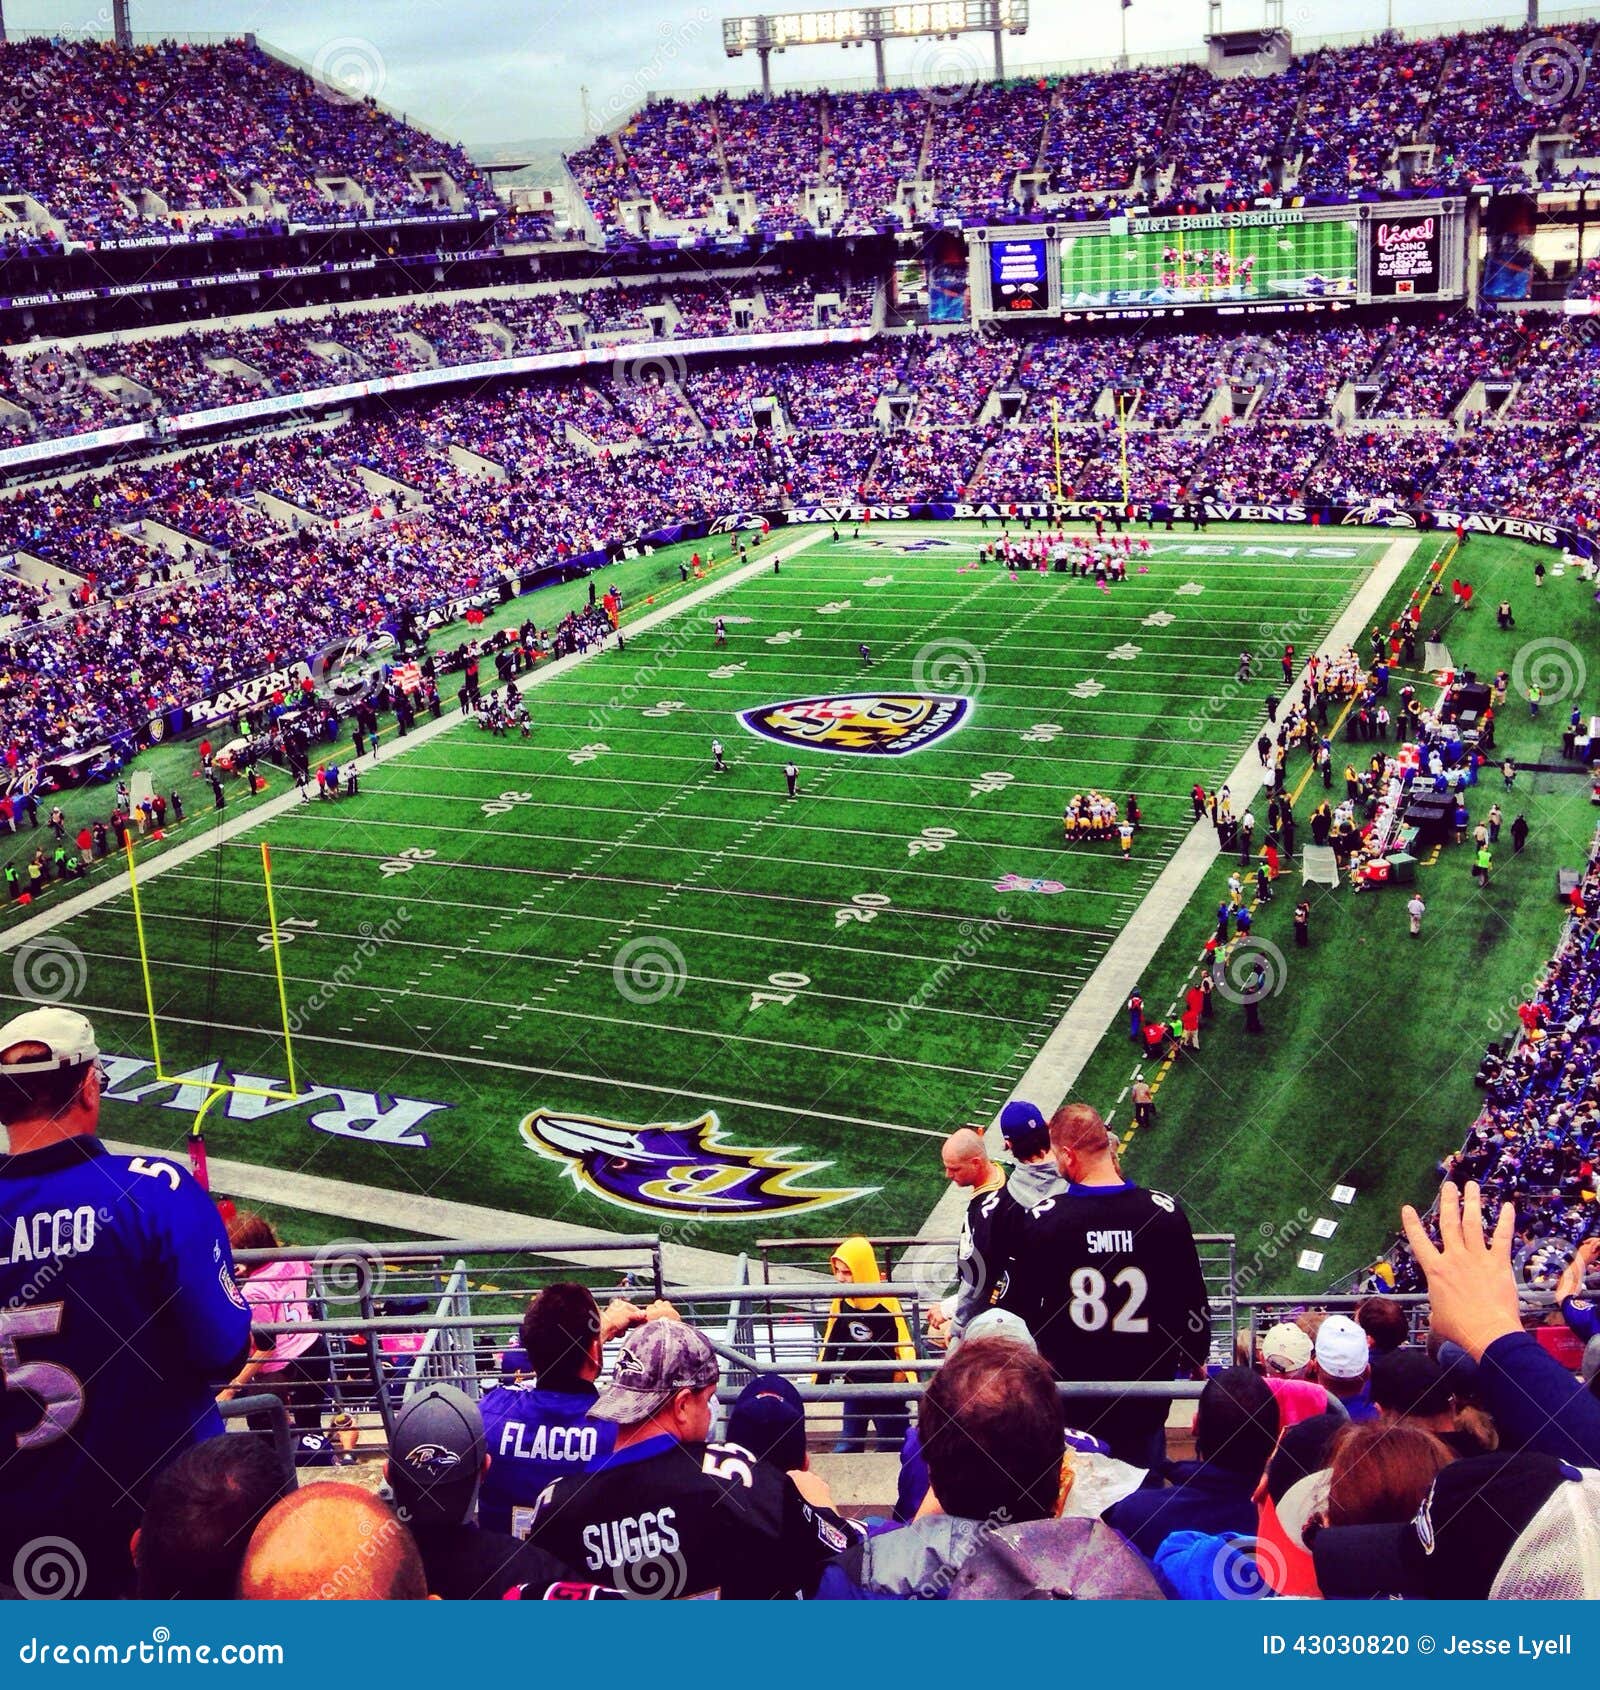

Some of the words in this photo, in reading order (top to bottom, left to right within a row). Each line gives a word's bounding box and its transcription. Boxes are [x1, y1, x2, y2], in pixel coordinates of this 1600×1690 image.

[1133, 217, 1169, 233] M&T
[1180, 214, 1223, 230] Bank
[1231, 209, 1304, 227] Stadium
[1378, 218, 1434, 246] Live!
[100, 242, 117, 250] AFC
[119, 235, 168, 249] CHAMPIONS
[1384, 242, 1426, 252] CASINO
[1396, 251, 1429, 260] SCORE
[783, 505, 909, 522] RAVENS
[1436, 511, 1558, 544] RAVENS
[886, 701, 957, 750] RAVENS
[568, 742, 611, 764] 40
[976, 770, 1015, 795] 40
[482, 791, 533, 816] 30
[909, 827, 959, 853] 30
[379, 847, 437, 877] 20
[836, 893, 892, 925] 20
[257, 917, 318, 950] 10
[751, 971, 812, 1008] 10
[127, 1155, 182, 1193] 5
[1086, 1230, 1133, 1254] SMITH
[1069, 1265, 1150, 1333] 82
[0, 1300, 86, 1450] 5
[500, 1421, 598, 1462] FLACCO
[583, 1506, 680, 1571] SUGGS
